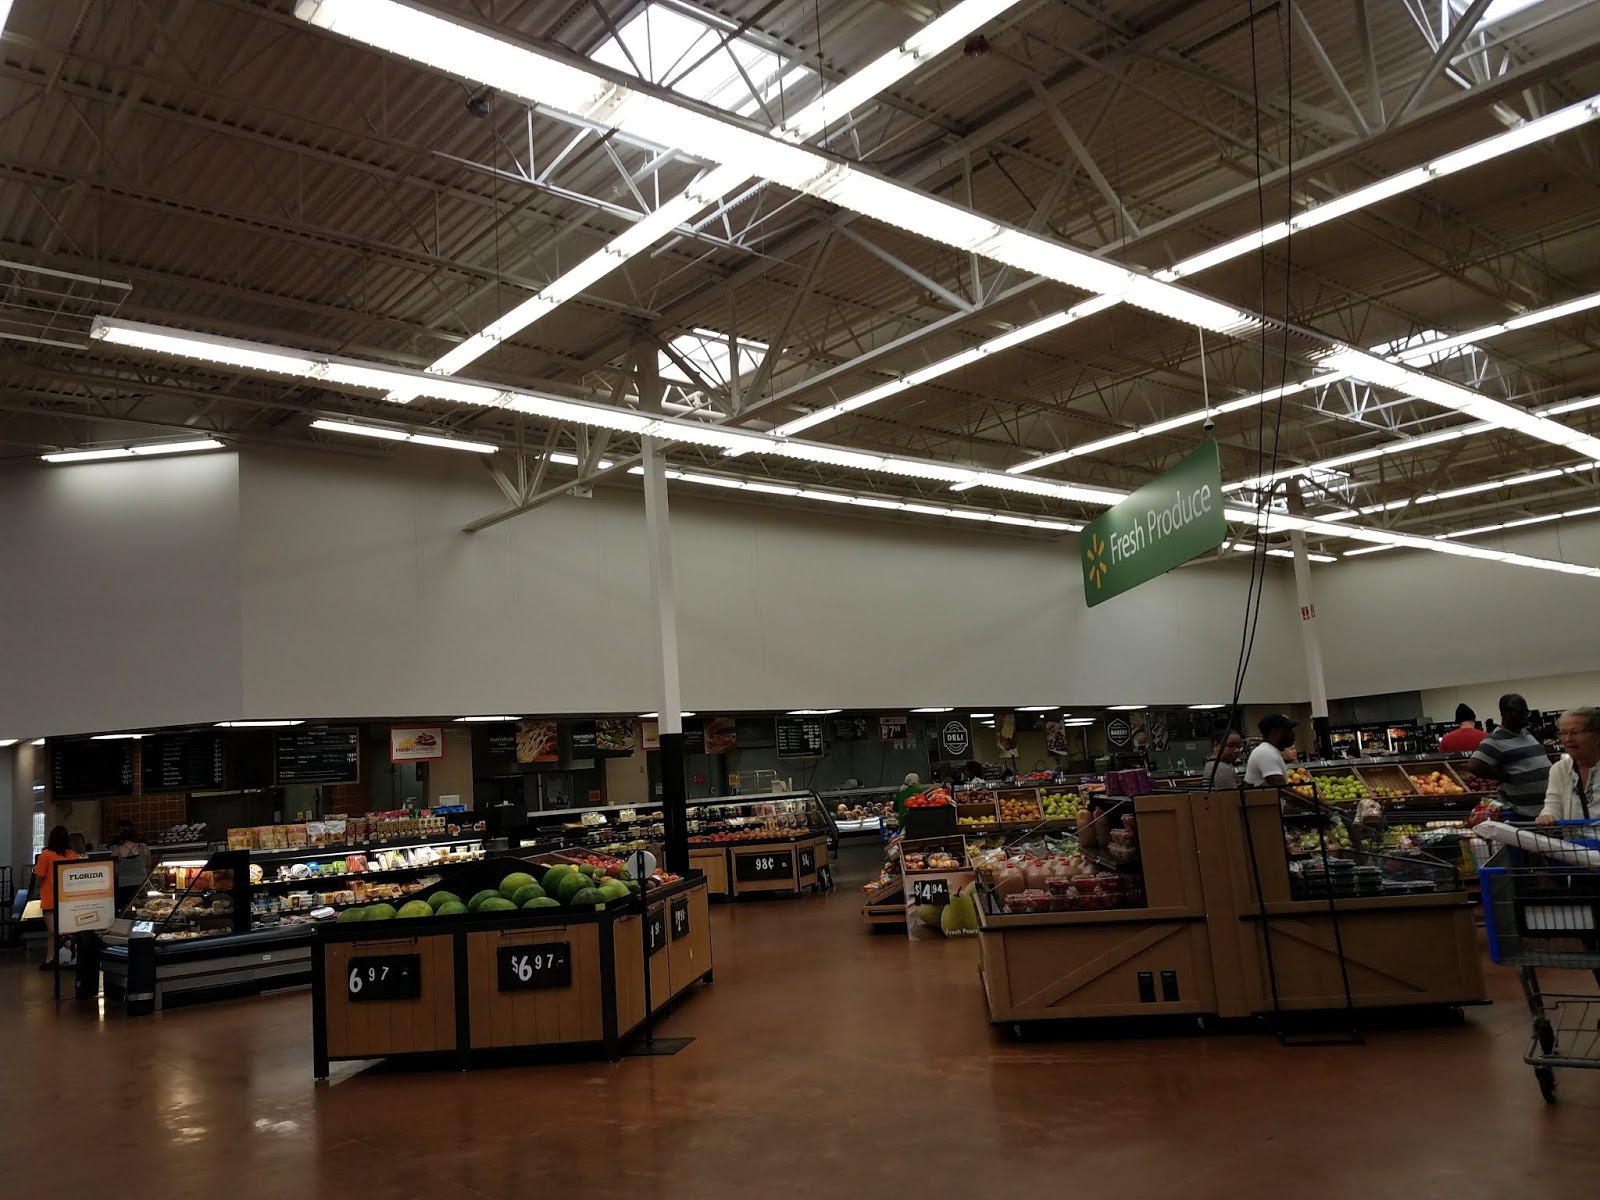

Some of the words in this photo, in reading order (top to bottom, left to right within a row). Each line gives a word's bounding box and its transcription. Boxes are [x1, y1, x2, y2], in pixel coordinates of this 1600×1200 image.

[1110, 518, 1145, 565] Fresh
[1147, 484, 1212, 545] Produce
[947, 733, 964, 742] DELI
[755, 857, 774, 871] 98¢
[69, 872, 104, 881] FLORIDA
[945, 928, 962, 936] Fresh
